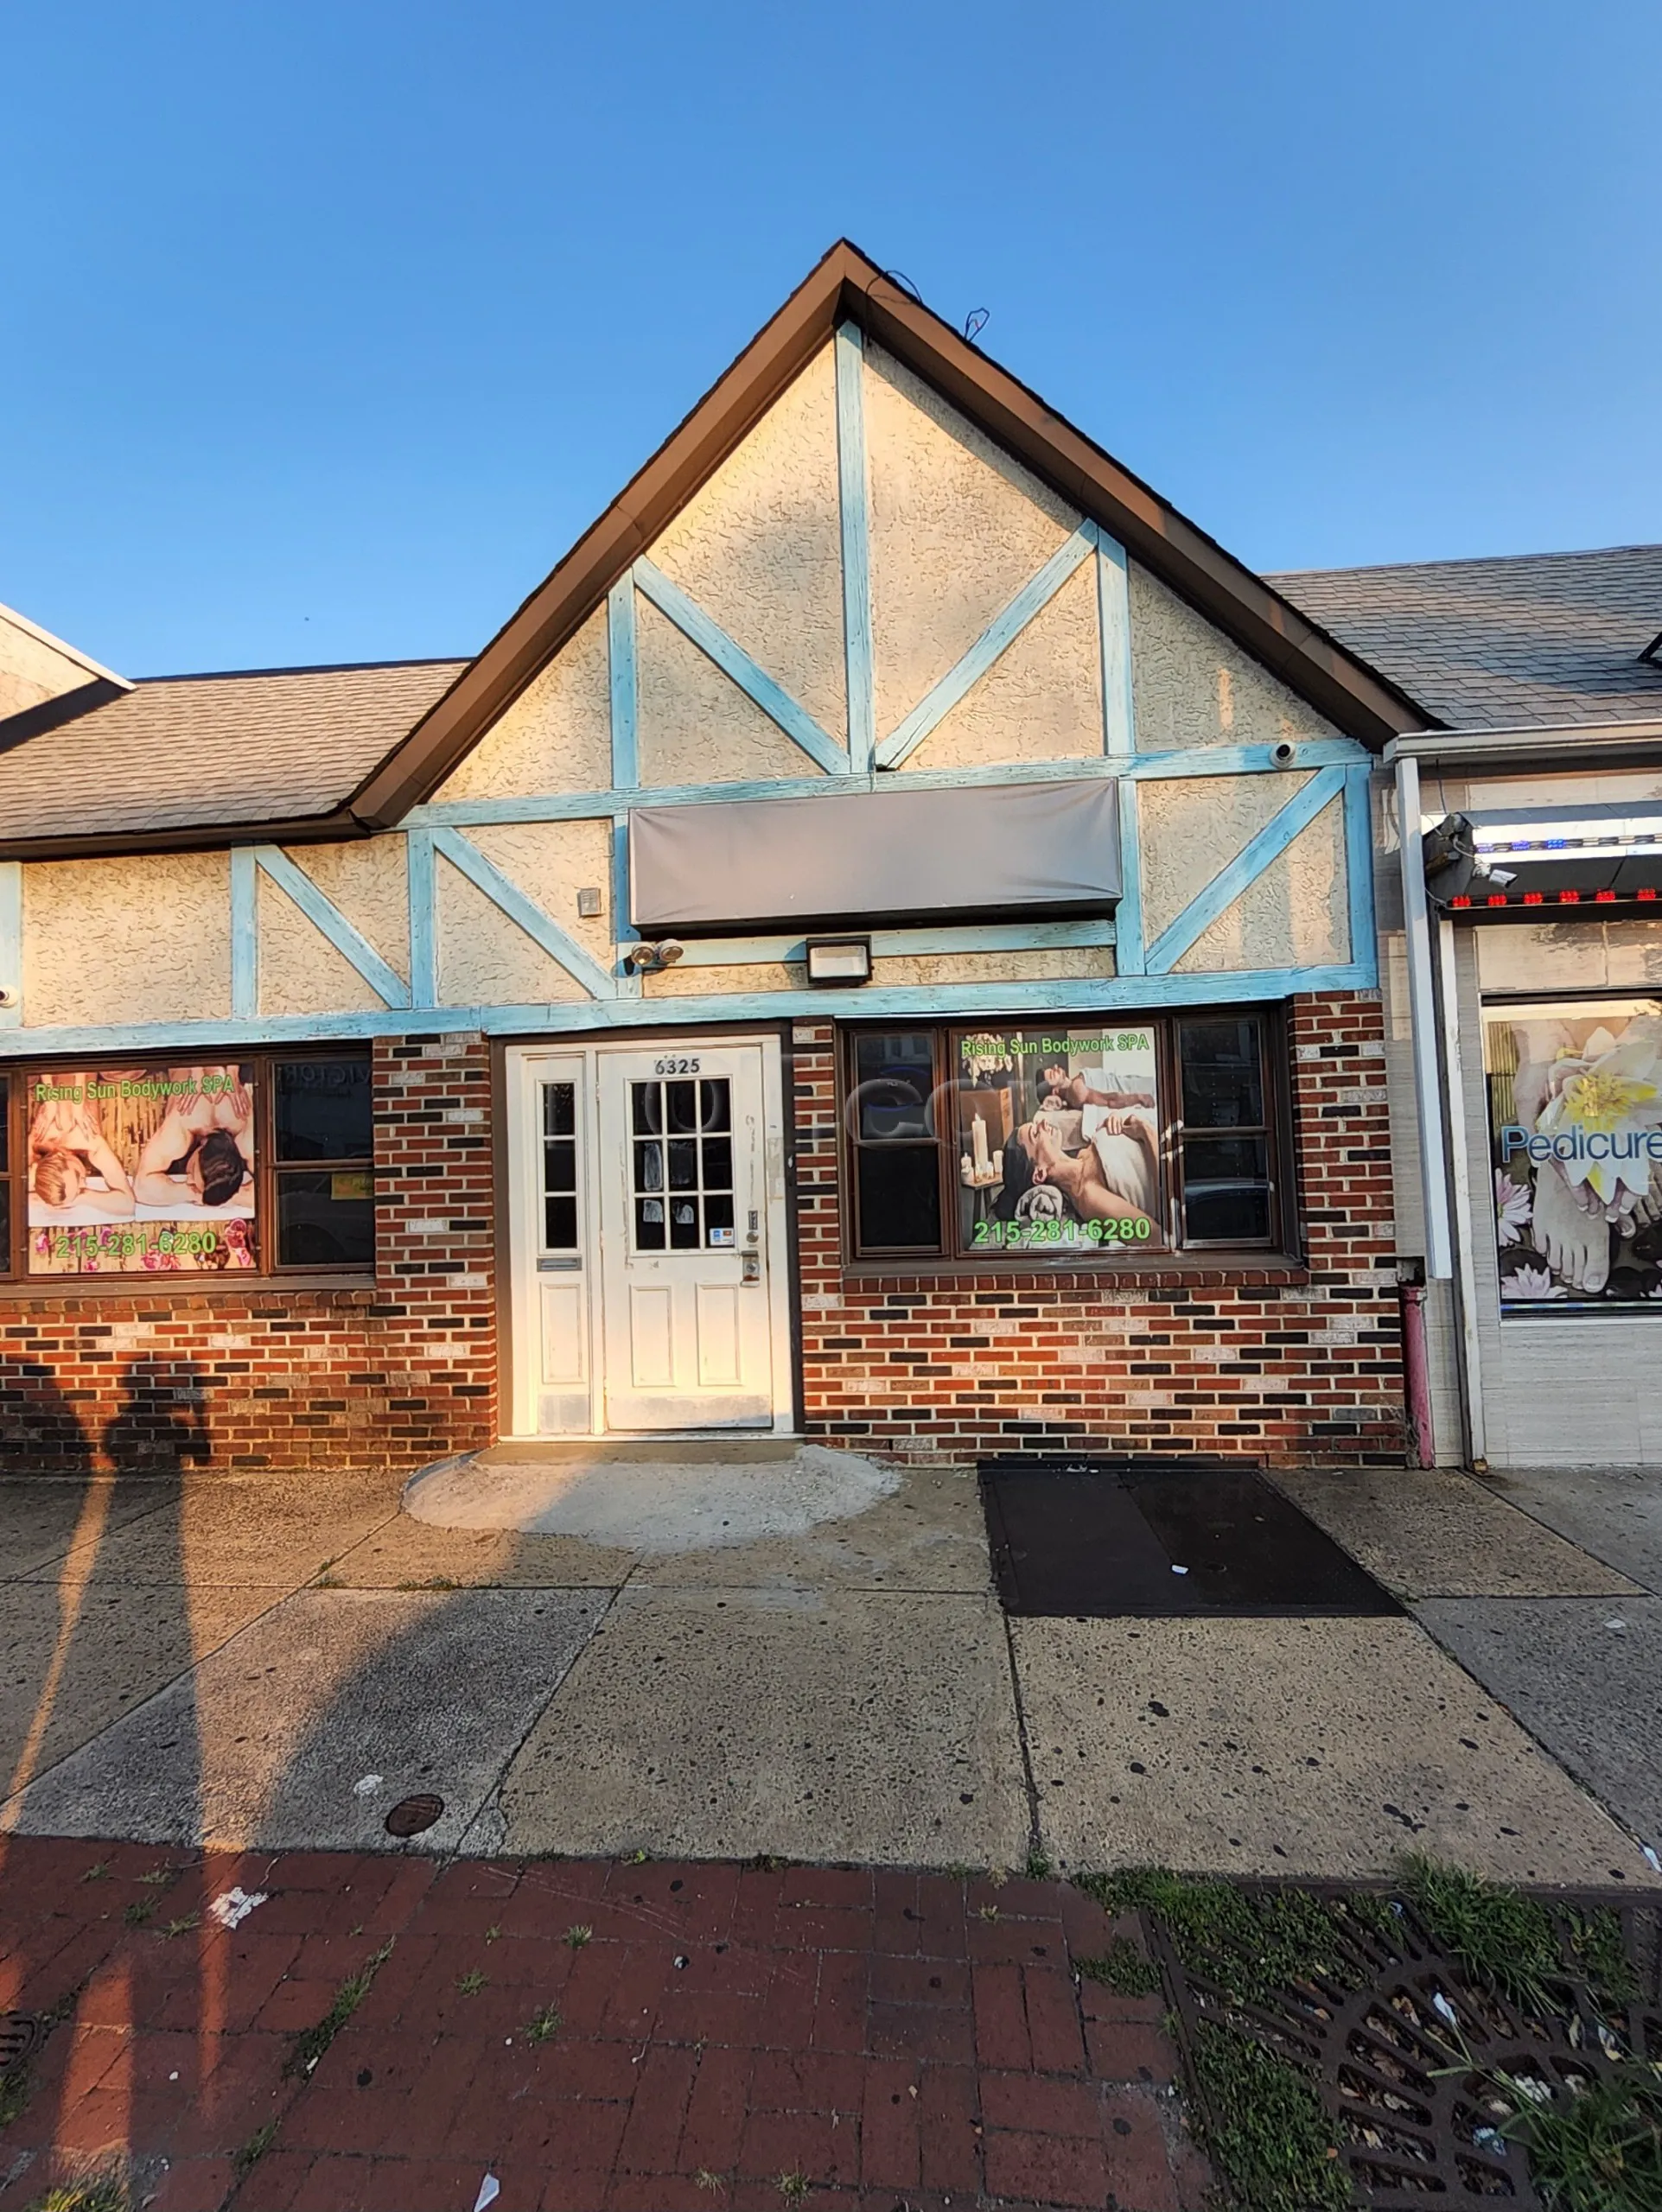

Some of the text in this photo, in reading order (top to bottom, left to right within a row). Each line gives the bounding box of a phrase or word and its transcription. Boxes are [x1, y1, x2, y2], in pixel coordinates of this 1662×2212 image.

[961, 1033, 1149, 1058] Rising Sun Bodywork SPA
[655, 1058, 700, 1075] 6325
[35, 1076, 235, 1104] Rising Sun Bodywork SPA
[1500, 1124, 1662, 1163] Pedicure
[973, 1217, 1151, 1243] 215-281-6280
[55, 1230, 217, 1259] 215-281-6280
